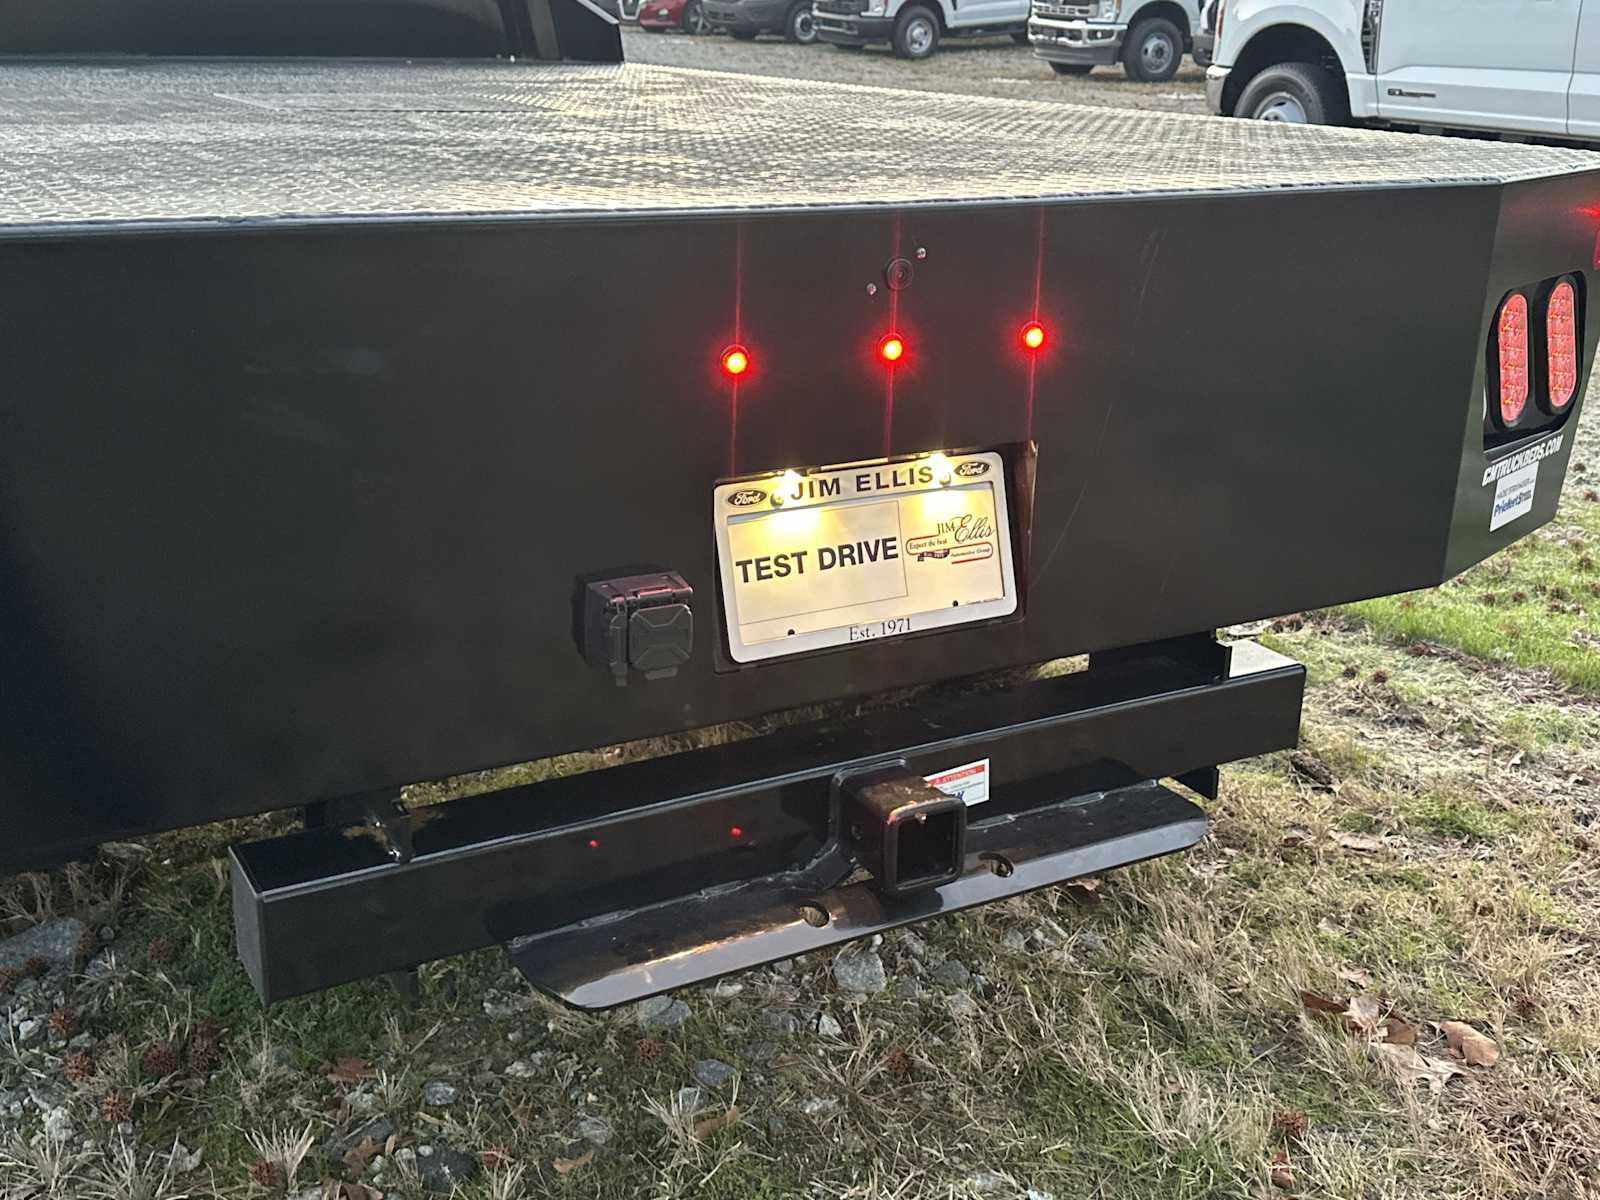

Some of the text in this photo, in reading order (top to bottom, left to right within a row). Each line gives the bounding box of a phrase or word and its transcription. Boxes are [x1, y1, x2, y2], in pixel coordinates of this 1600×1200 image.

[959, 461, 987, 476] Ford
[790, 466, 934, 500] JIM ELLIS
[732, 490, 763, 505] Ford
[936, 514, 994, 543] JIM Ellis
[936, 538, 948, 546] best
[735, 536, 899, 583] TEST DRIVE
[849, 617, 913, 641] Est. 1971
